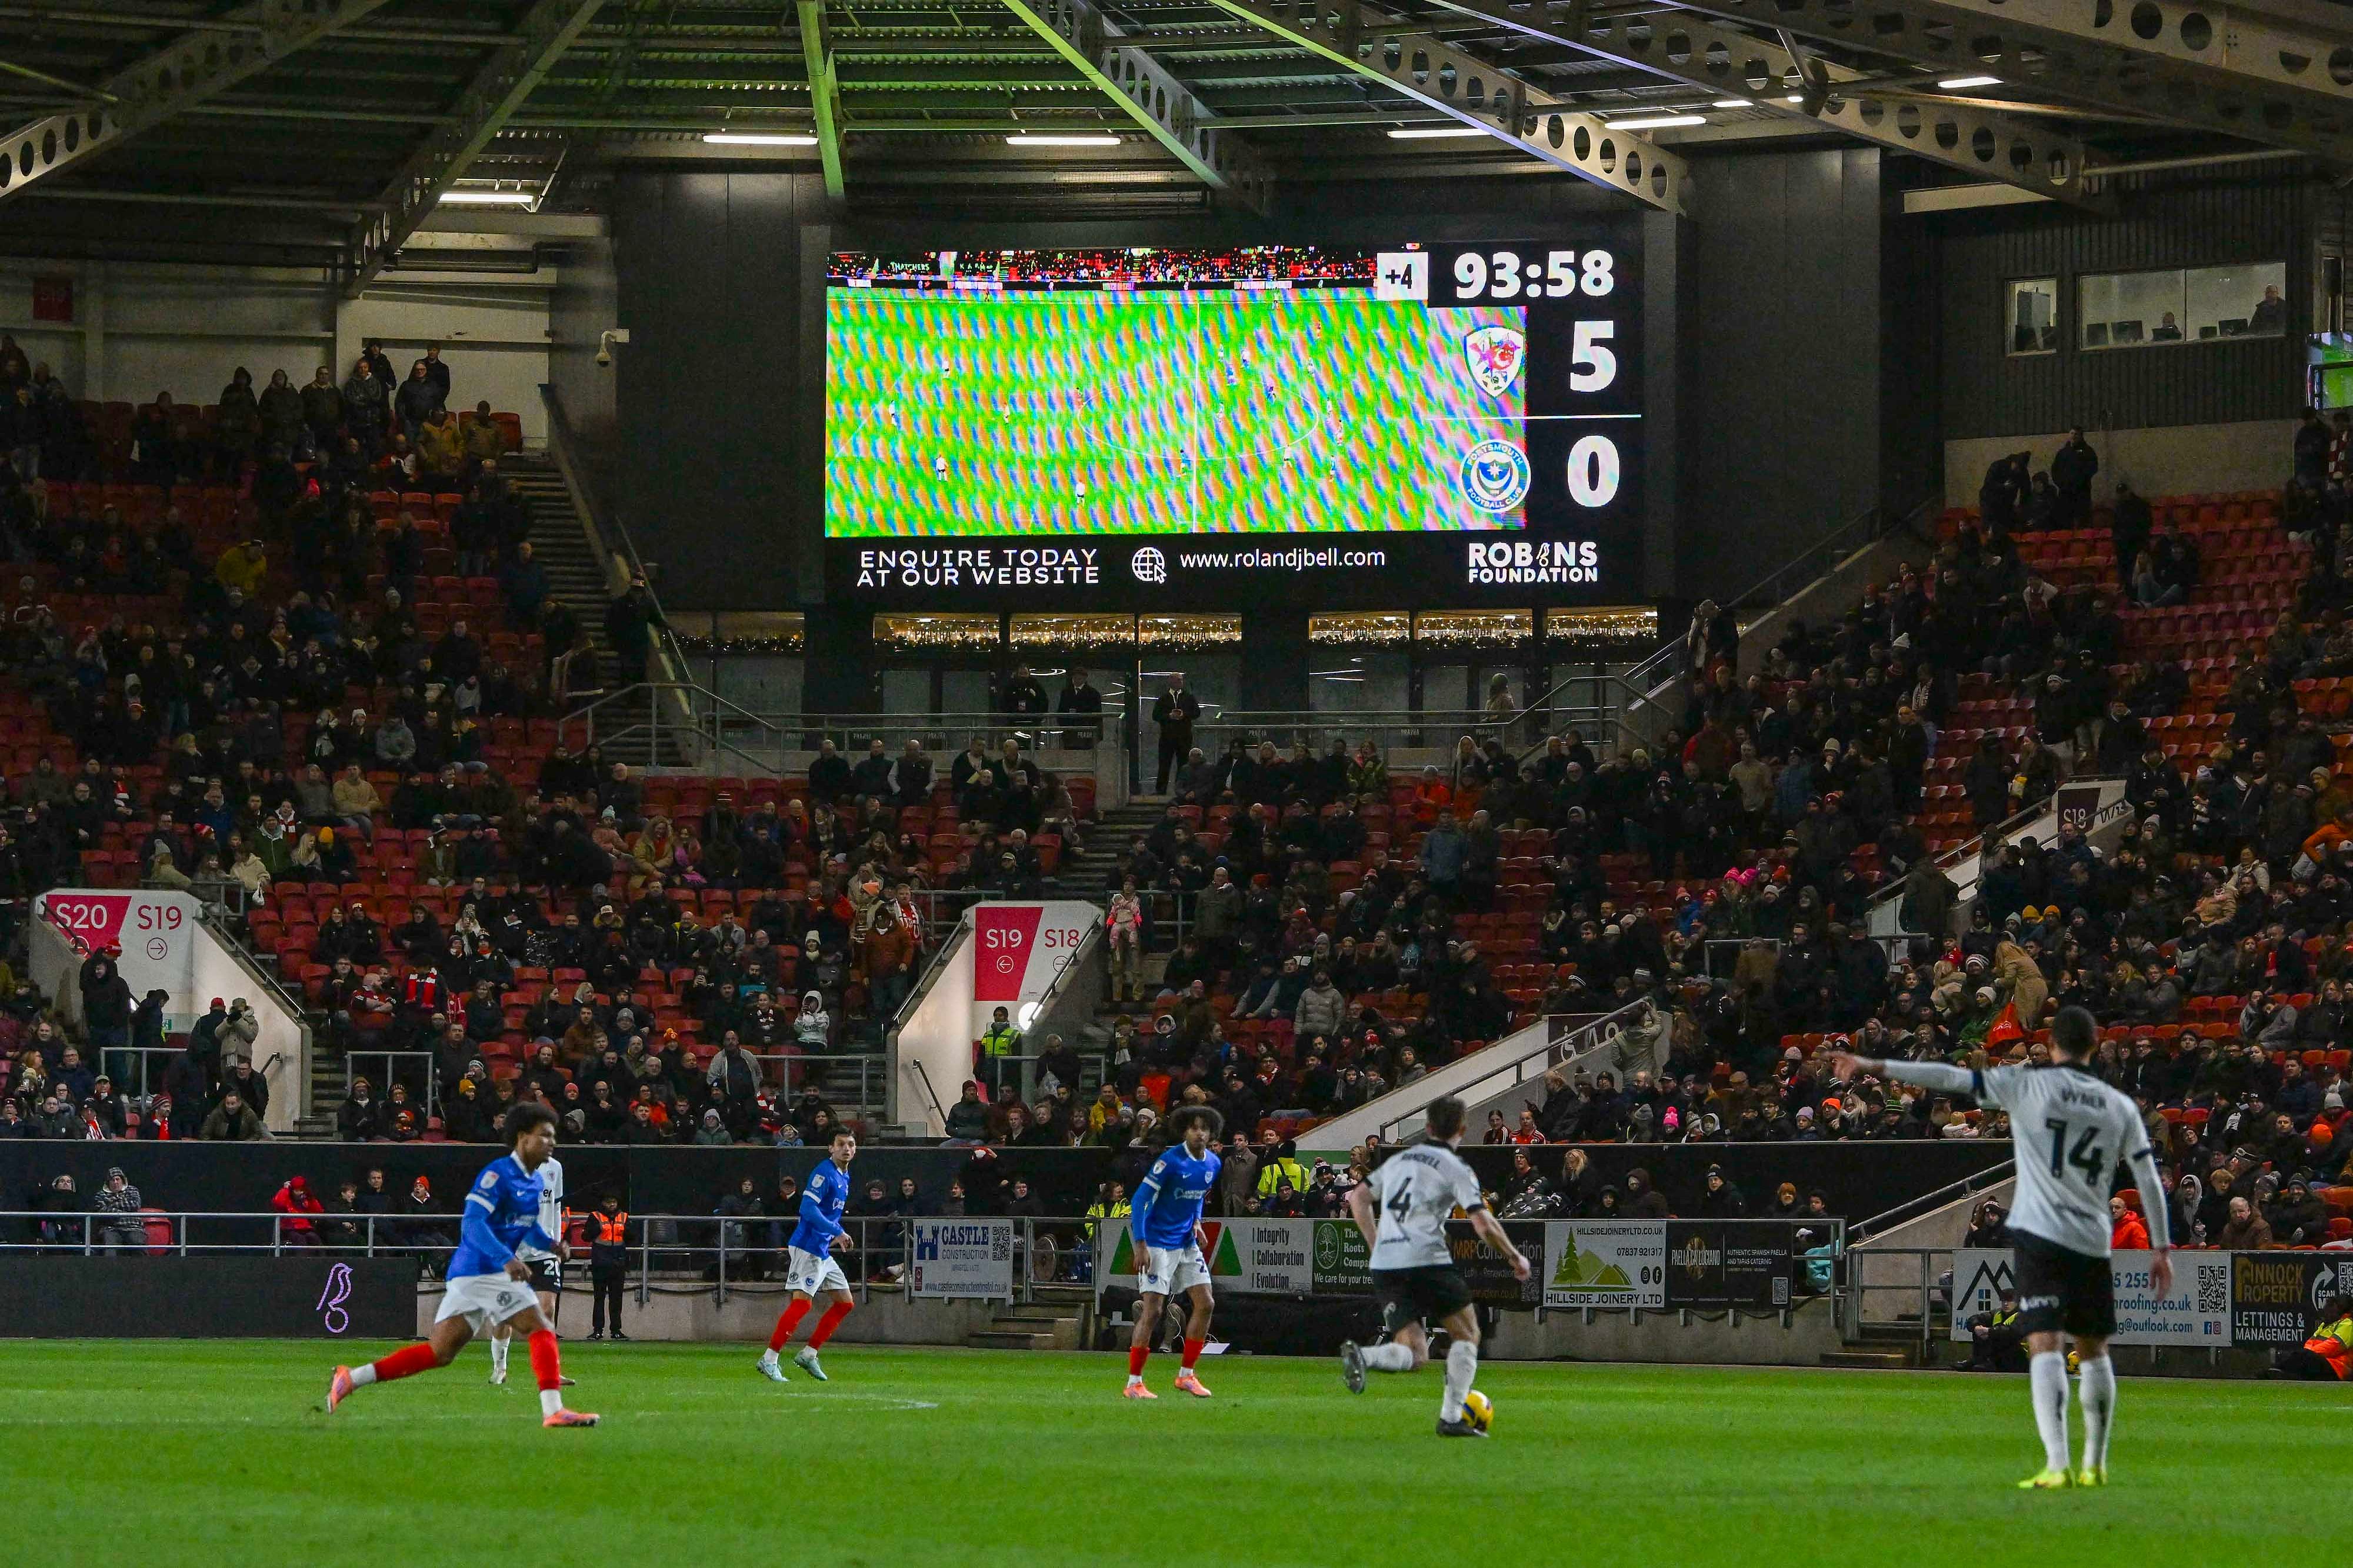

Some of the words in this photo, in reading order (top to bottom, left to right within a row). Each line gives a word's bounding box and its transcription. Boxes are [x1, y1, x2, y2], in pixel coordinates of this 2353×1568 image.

[1385, 264, 1412, 289] +4
[1454, 250, 1614, 299] 93:58
[1570, 321, 1617, 392] 5
[1567, 435, 1619, 507] 0
[861, 550, 991, 569] ENQUIRE
[1003, 549, 1097, 566] TODAY
[1180, 548, 1385, 571] www.rolandjbell.com
[857, 569, 890, 587] AT
[901, 568, 959, 586] OUR
[972, 566, 1099, 585] WEBSITE
[1468, 568, 1598, 583] FOUNDATION
[56, 903, 108, 929] S20
[137, 905, 182, 930] S19
[986, 929, 1022, 949] S19
[1044, 929, 1079, 948] S18
[2045, 1118, 2104, 1187] 14
[1387, 1176, 1413, 1224] 4
[942, 1226, 989, 1246] CASTLE
[1257, 1227, 1289, 1246] Integrity
[1344, 1228, 1358, 1239] The
[942, 1249, 989, 1260] CONSTRUCTION
[1344, 1242, 1365, 1253] Roots
[1454, 1239, 1543, 1260] MRPConction
[1617, 1248, 1637, 1256] 07837
[1639, 1248, 1663, 1256] 921317
[1257, 1250, 1304, 1266] Collaboration
[1344, 1257, 1370, 1269] Compa
[1257, 1273, 1289, 1289] Evolution
[1314, 1272, 1324, 1283] We
[1325, 1275, 1337, 1283] care
[1348, 1275, 1362, 1287] your
[1546, 1293, 1593, 1304] HILLSIDE
[1595, 1293, 1640, 1304] JOINERY
[1643, 1294, 1662, 1304] LTD
[2318, 1290, 2335, 1298] SCAN
[2114, 1293, 2192, 1315] roofing.co.uk
[2116, 1317, 2193, 1335] g@outlook.com
[2235, 1311, 2294, 1327] LETTINGS
[2297, 1312, 2305, 1327] &
[2235, 1327, 2305, 1341] MANAGEMENT
